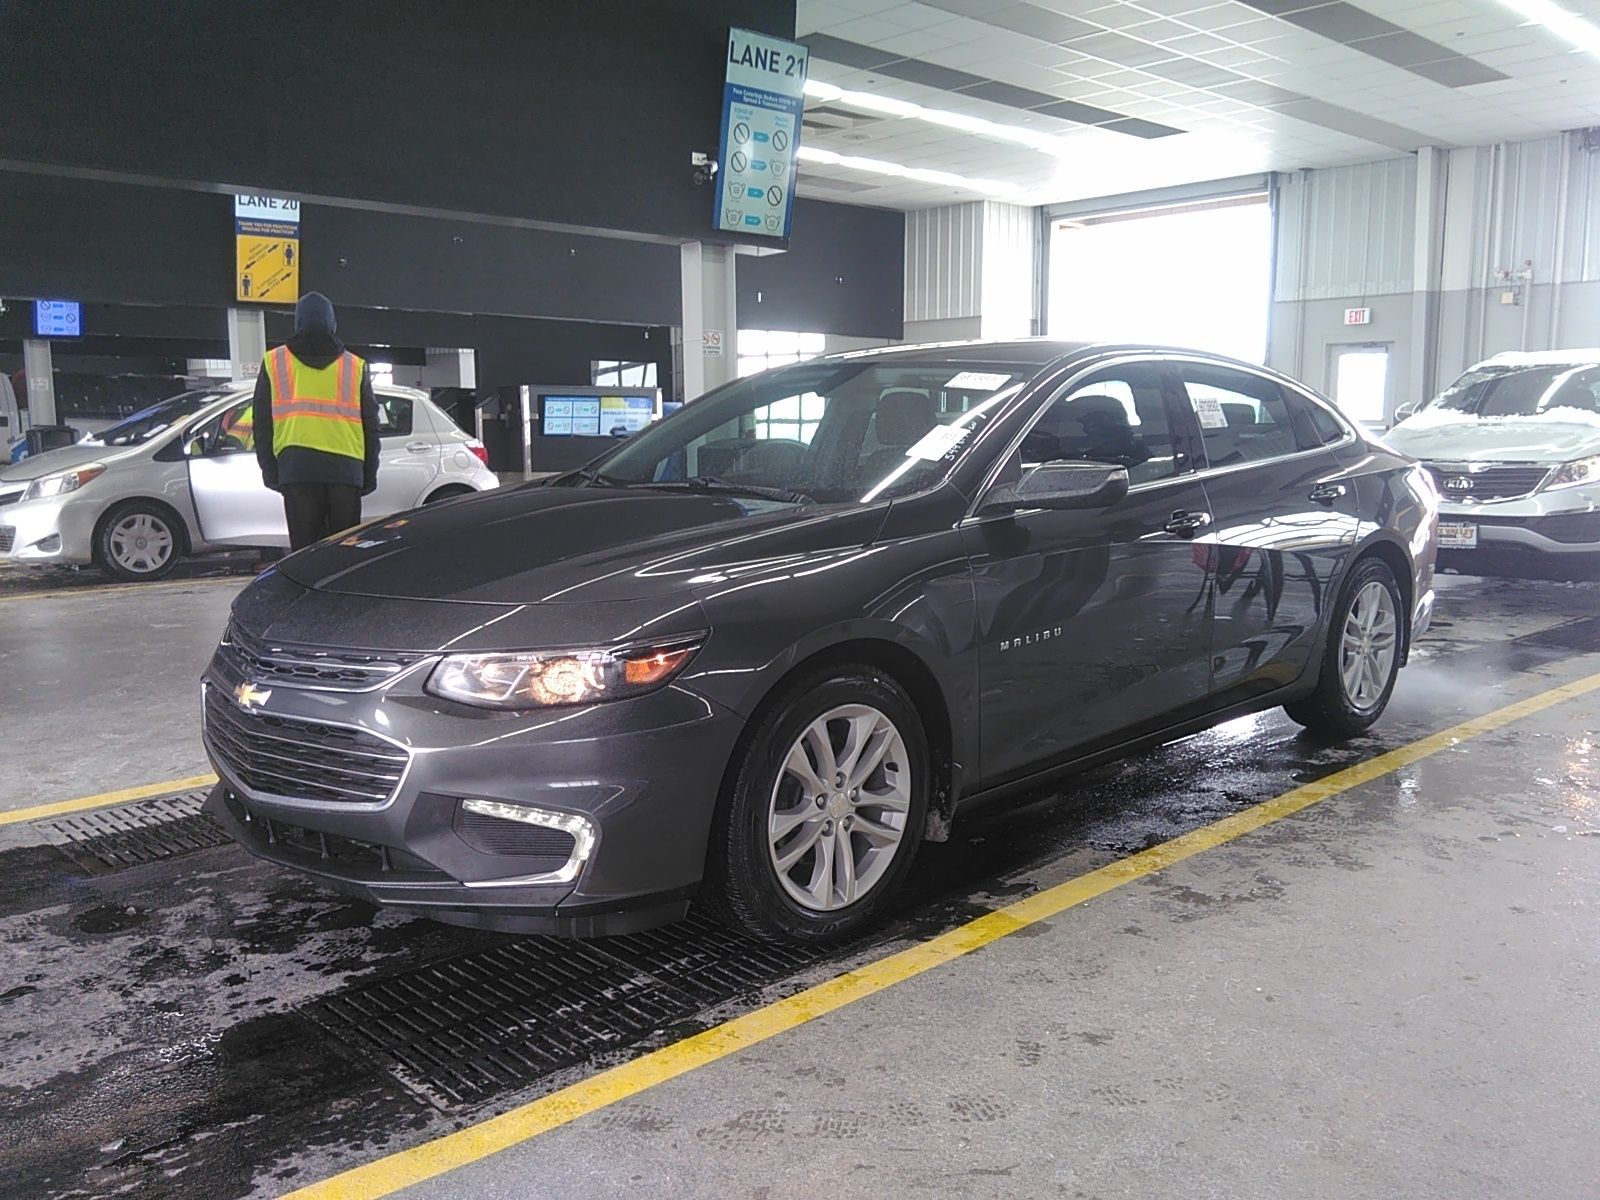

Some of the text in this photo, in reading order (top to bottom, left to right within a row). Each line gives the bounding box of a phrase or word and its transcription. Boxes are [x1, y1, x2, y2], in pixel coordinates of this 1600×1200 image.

[729, 41, 805, 79] LANE 21
[238, 194, 298, 211] LANE 20
[1349, 309, 1367, 323] EXIT
[1447, 479, 1469, 489] KIA
[1000, 627, 1062, 652] MALIBU
